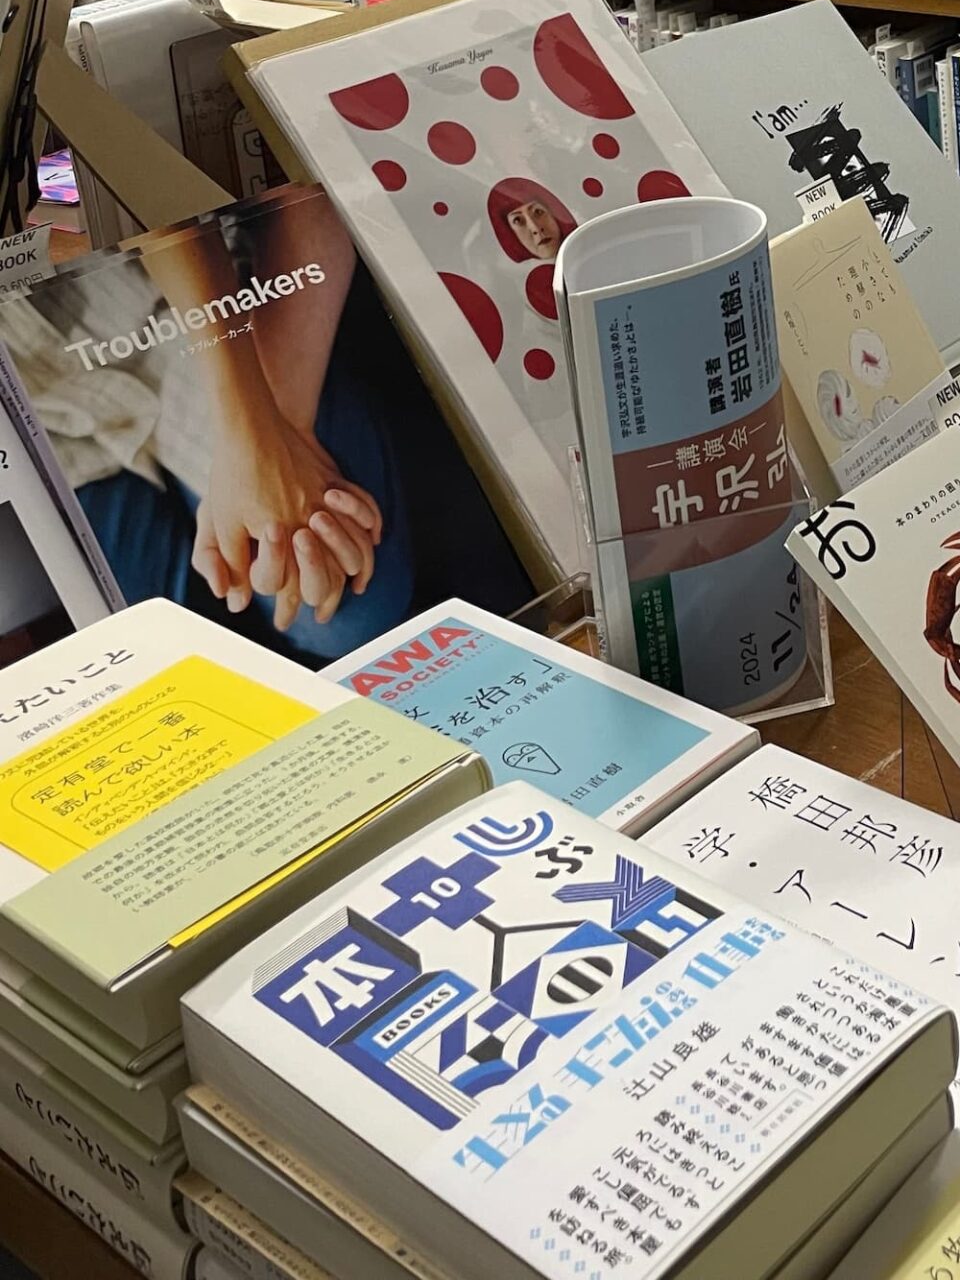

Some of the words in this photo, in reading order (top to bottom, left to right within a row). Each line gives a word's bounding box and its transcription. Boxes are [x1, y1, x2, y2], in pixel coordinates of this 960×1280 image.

[805, 185, 827, 205] NEW
[0, 230, 36, 251] NEW
[64, 261, 326, 372] Troublemakers
[179, 320, 255, 357] トラブルメーカーズ
[704, 356, 727, 415] 講演者
[800, 499, 876, 580] お
[739, 631, 761, 686] 2024
[30, 710, 189, 806] 定有堂で一番
[51, 722, 208, 819] 読んで欲しい本
[408, 876, 461, 912] 10
[279, 940, 396, 1030] 本
[379, 983, 457, 1049] BOOKS
[759, 1021, 850, 1079] ますます価値
[795, 992, 882, 1045] されつつある
[621, 1019, 722, 1102] 辻山良雄
[720, 1052, 788, 1093] ています。
[740, 1034, 828, 1092] があると思っ
[635, 1128, 726, 1192] ろにはきっと
[653, 1108, 745, 1173] 読み終えるこ
[568, 1184, 664, 1257] 愛すべき本屋
[592, 1165, 683, 1232] こし偏屈でも
[547, 1207, 634, 1269] を訪ねる旅。
